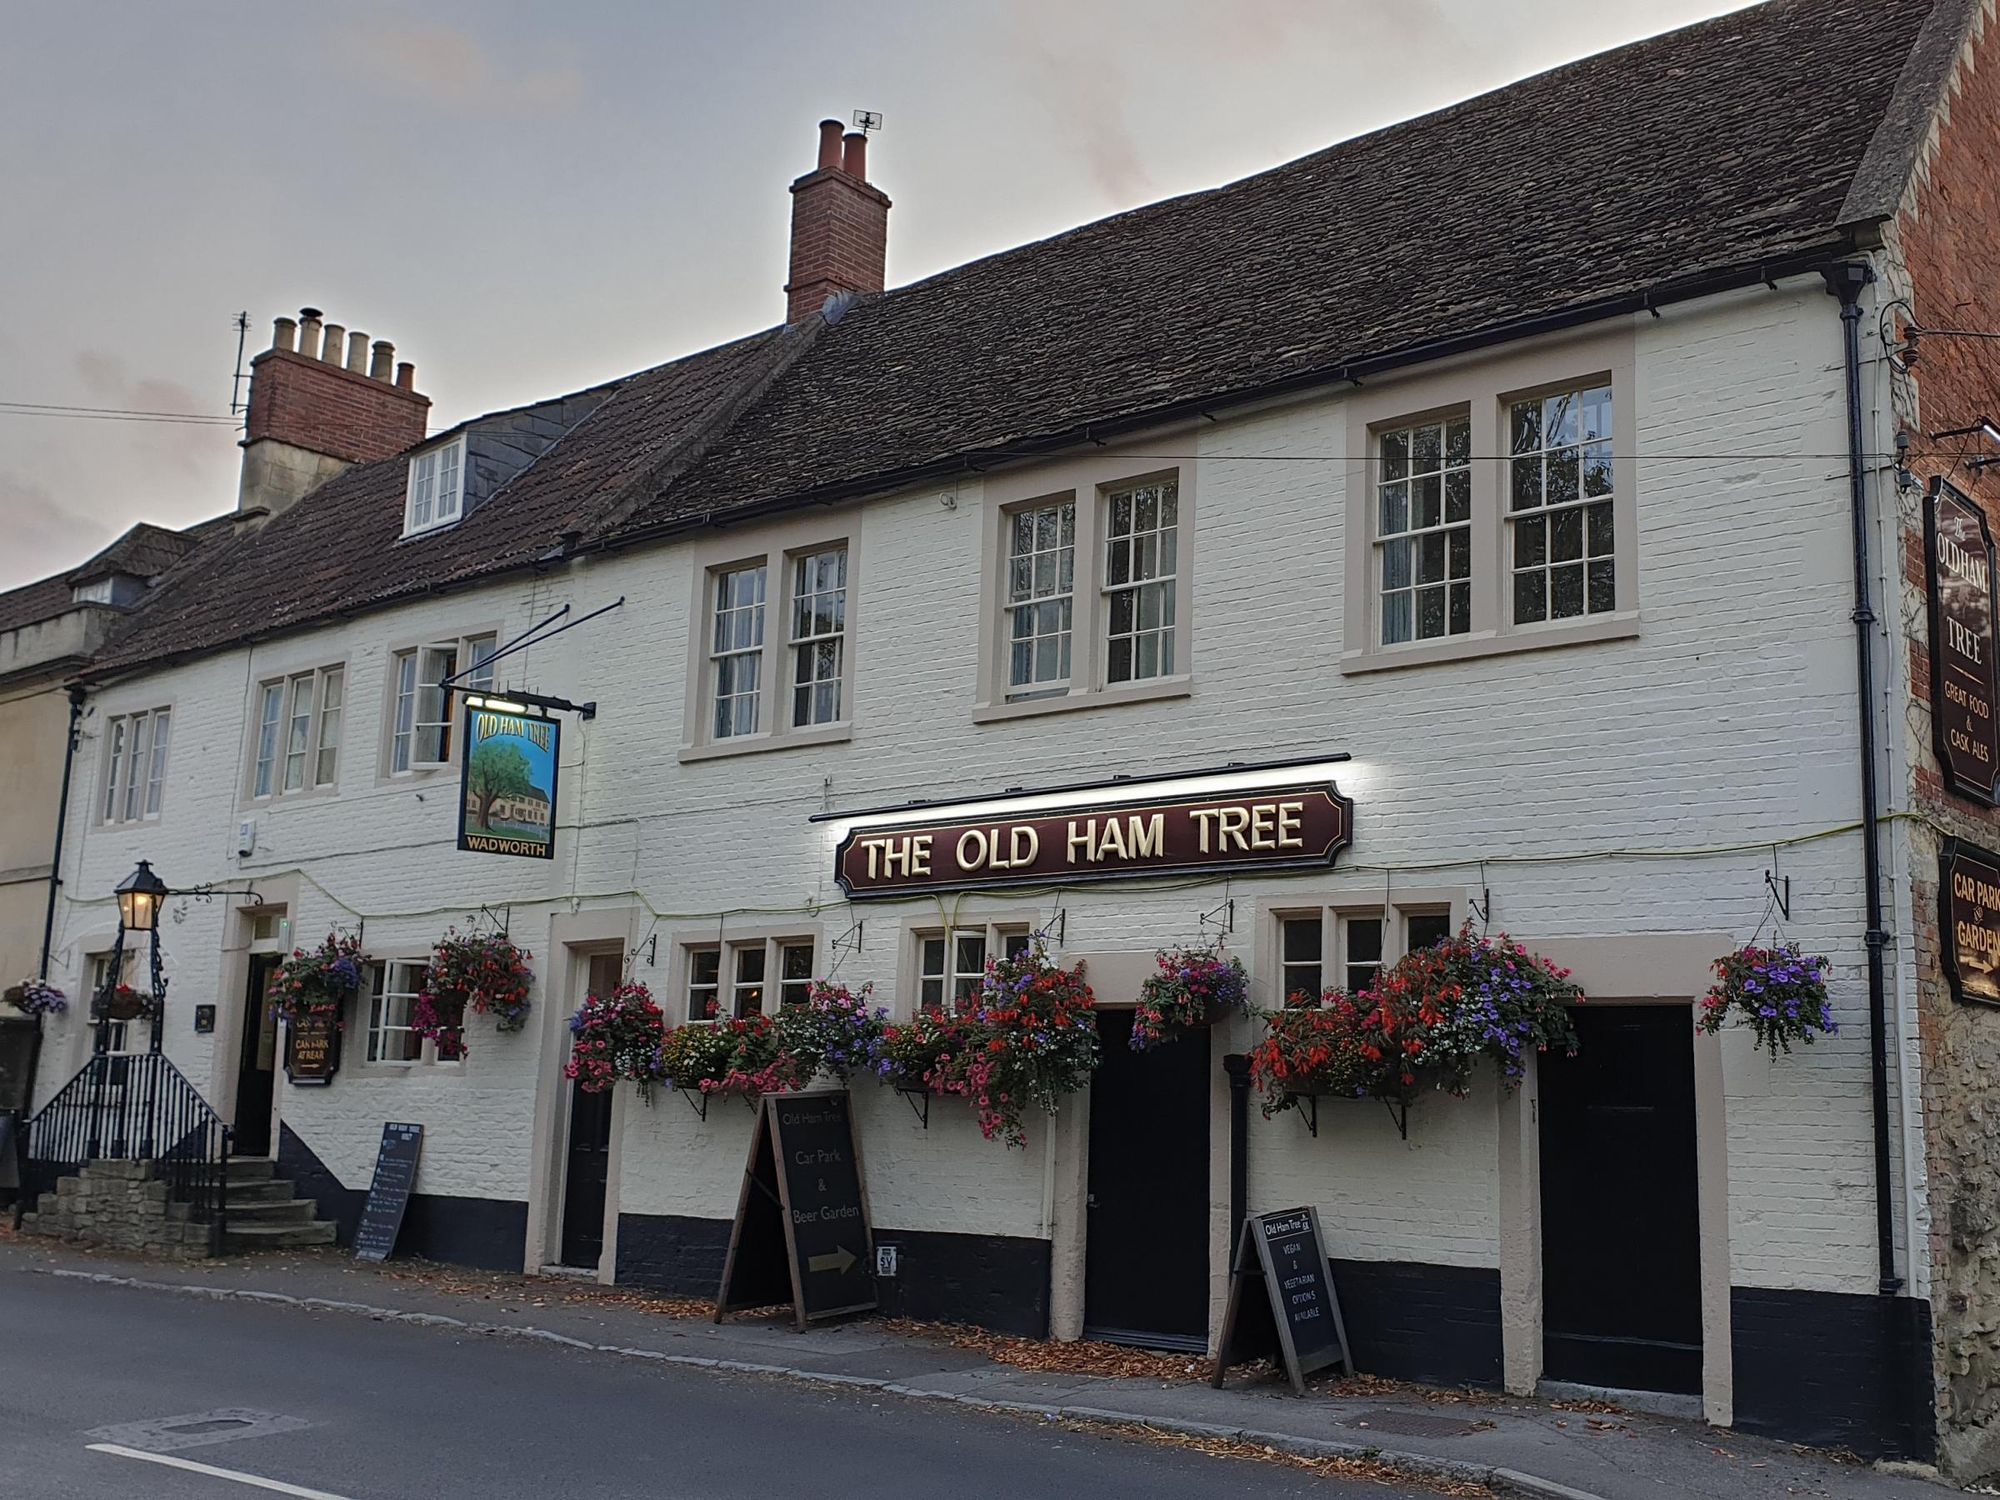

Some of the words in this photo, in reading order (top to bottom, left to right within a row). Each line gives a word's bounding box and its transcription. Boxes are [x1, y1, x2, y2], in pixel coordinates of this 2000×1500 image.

[1946, 615, 1982, 665] TREE
[1944, 679, 1967, 710] GREAT
[1968, 692, 1989, 720] FOOD
[476, 713, 498, 743] OLD
[500, 715, 524, 738] HAM
[527, 722, 551, 753] TREE
[1966, 715, 1973, 732] &
[1950, 727, 1970, 754] CASK
[1972, 740, 1989, 763] ALES
[467, 836, 546, 857] WADWORTH
[860, 834, 933, 881] THE
[956, 825, 1040, 872] OLD
[1066, 813, 1164, 865] HAM
[1189, 801, 1303, 854] TREE
[1954, 872, 1975, 903] CAR
[1958, 920, 2000, 955] GARDEN
[795, 1150, 816, 1165] Car
[817, 1148, 841, 1162] Park
[818, 1178, 827, 1192] &
[793, 1208, 818, 1224] Beer
[821, 1204, 859, 1219] Garden
[1266, 1224, 1277, 1235] Old
[1277, 1222, 1289, 1233] Ham
[1289, 1219, 1301, 1230] Tree
[1283, 1243, 1301, 1255] VEGAN
[1292, 1291, 1316, 1304] OPTIONS
